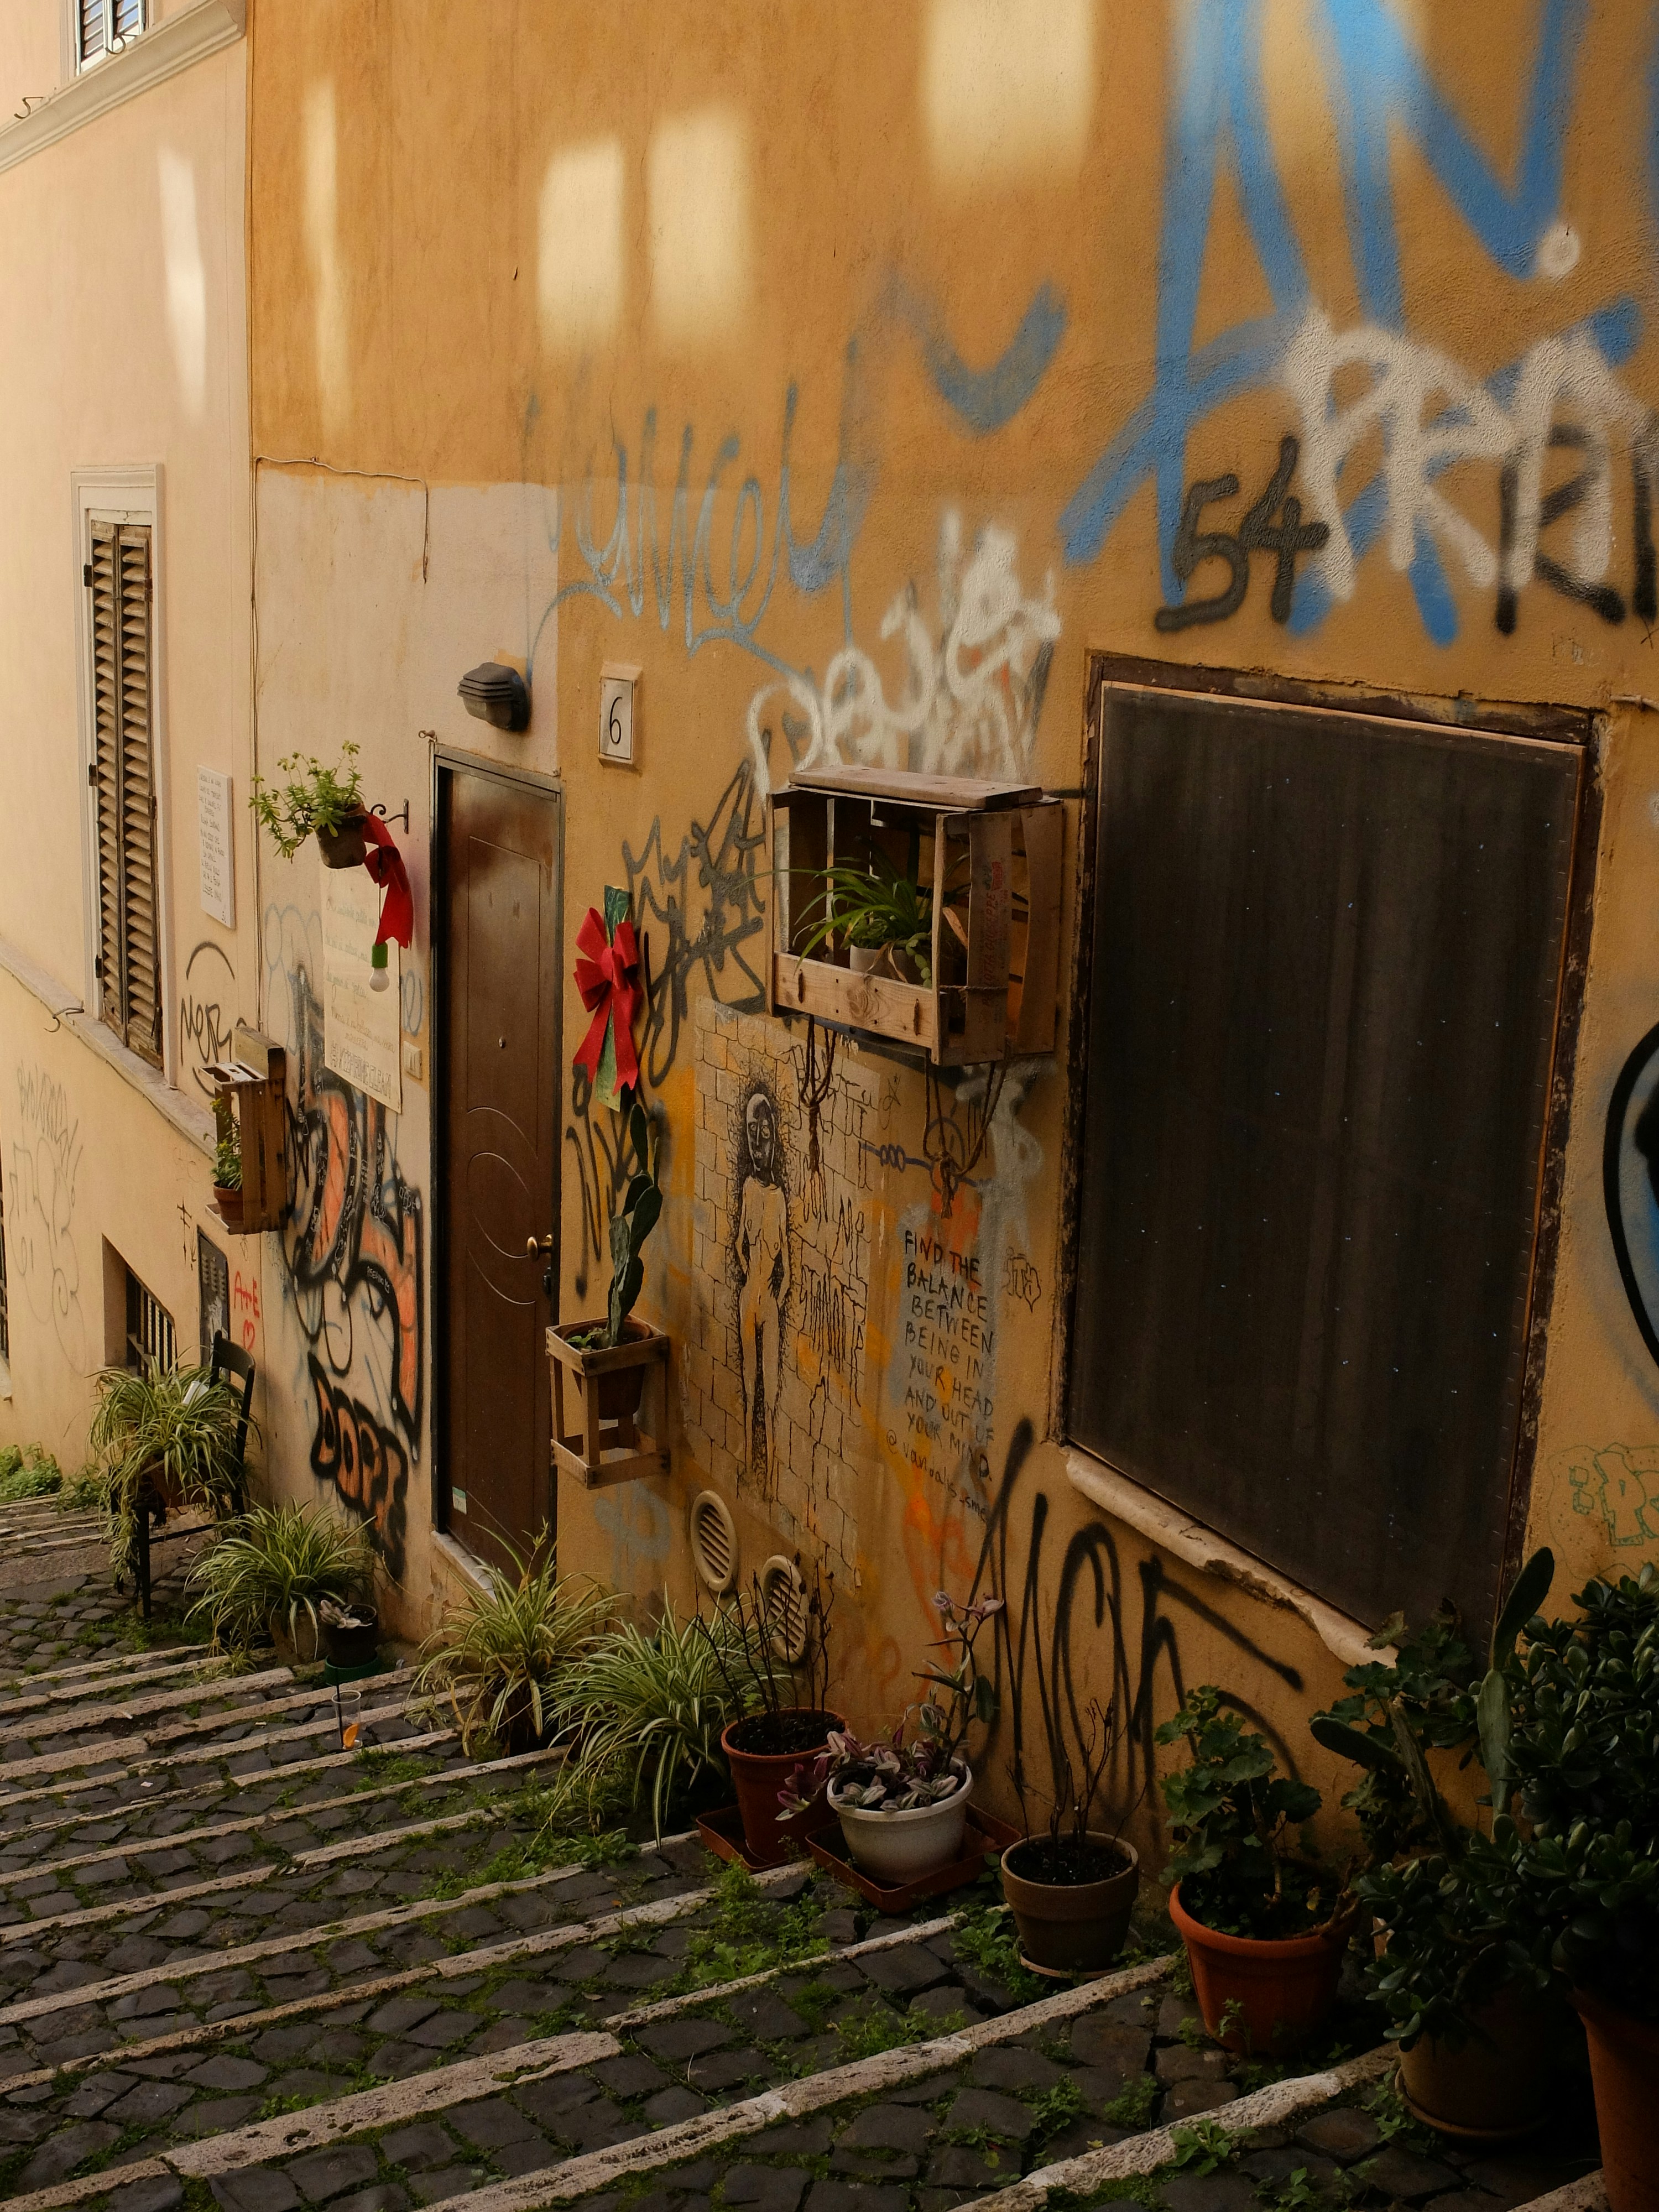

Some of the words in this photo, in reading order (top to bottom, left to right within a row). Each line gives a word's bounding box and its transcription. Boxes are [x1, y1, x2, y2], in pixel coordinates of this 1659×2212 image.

[609, 696, 622, 745] 6
[905, 1230, 943, 1267] FIND
[949, 1250, 983, 1287] THE
[907, 1262, 988, 1323] BALANCE
[905, 1320, 960, 1364] BEING
[966, 1354, 984, 1380] IN
[911, 1294, 994, 1353] BETWEEN
[909, 1354, 945, 1392] YOUR
[952, 1377, 994, 1416] HEAD
[907, 1411, 943, 1449] YOUR
[942, 1401, 970, 1433] OUT
